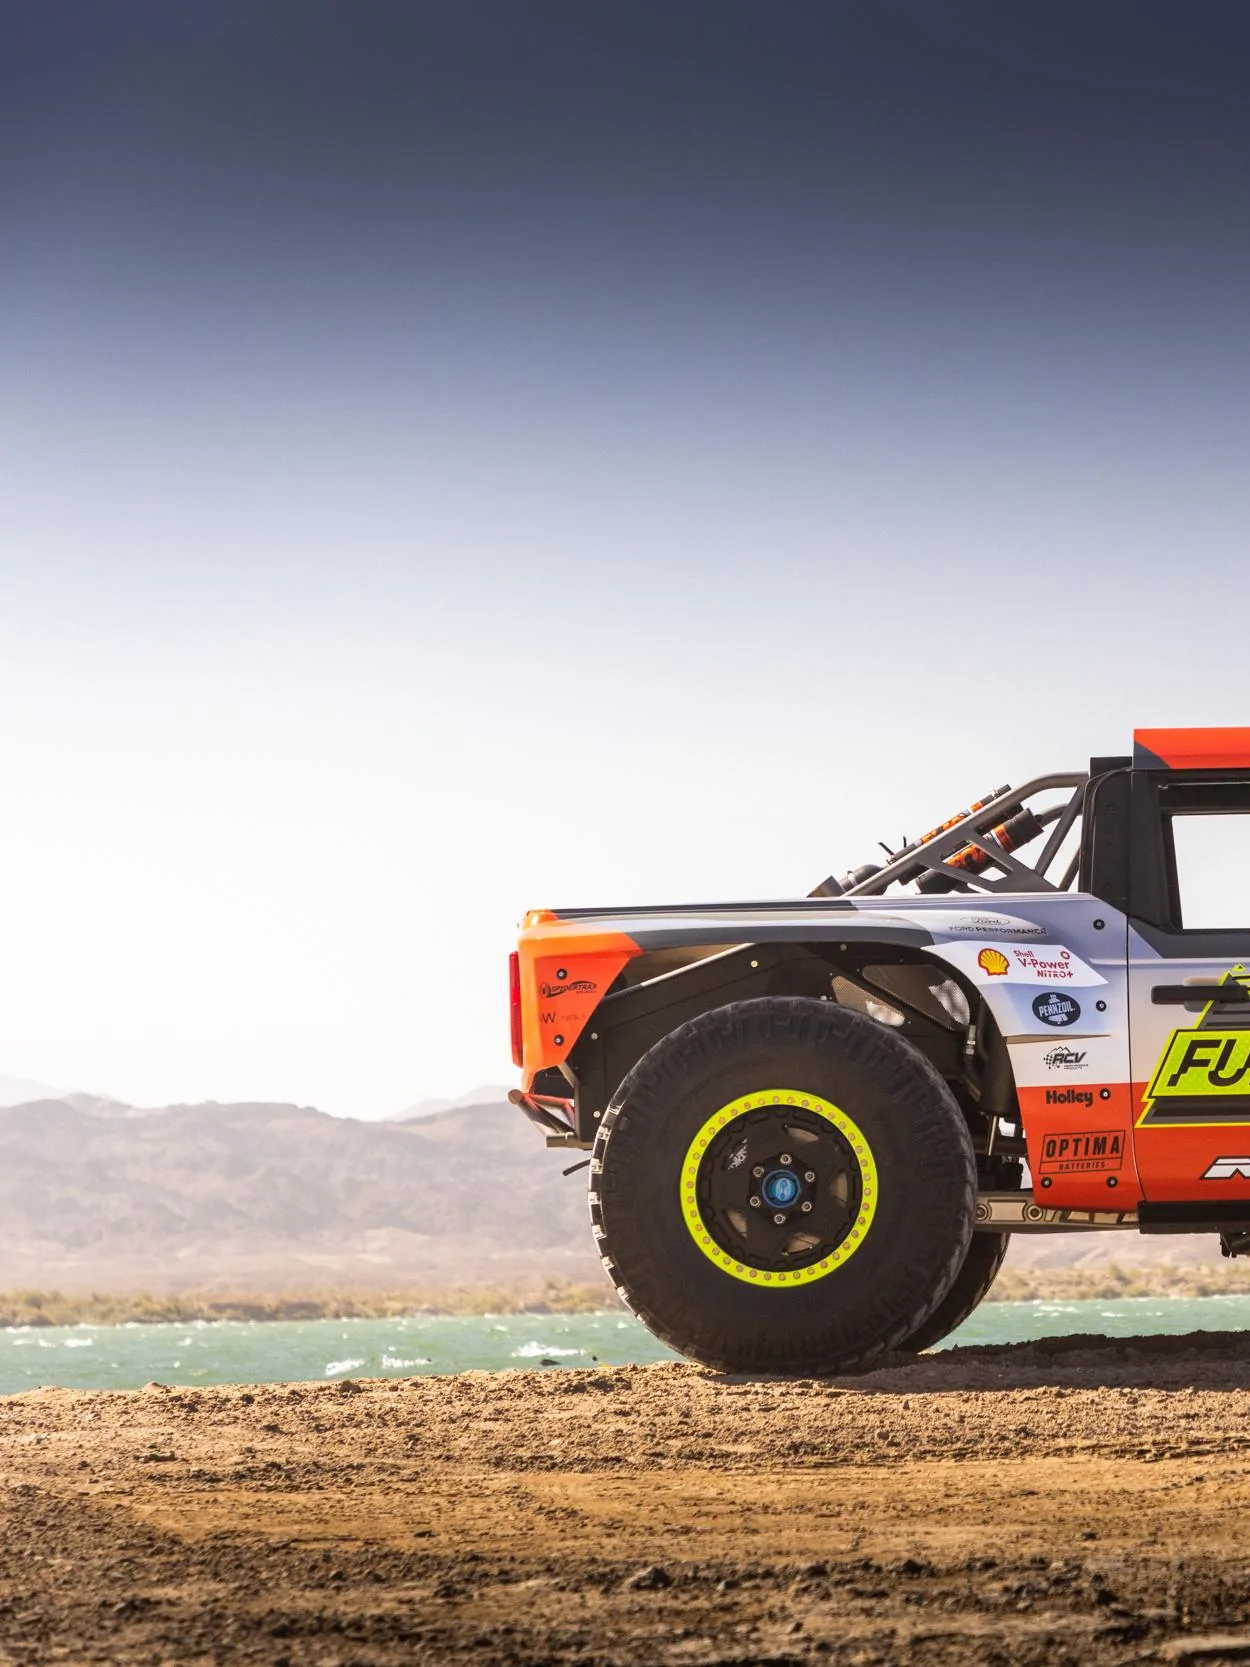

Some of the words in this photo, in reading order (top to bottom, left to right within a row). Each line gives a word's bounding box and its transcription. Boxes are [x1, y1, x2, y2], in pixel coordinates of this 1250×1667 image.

[976, 926, 1048, 934] PERFORMANCE
[1013, 950, 1034, 958] Shell
[1017, 958, 1070, 970] V-Power
[1038, 1001, 1074, 1017] PENNZOIL
[1051, 1052, 1087, 1064] RCV
[1045, 1089, 1093, 1108] Holley
[1046, 1135, 1120, 1158] OPTIMA
[1058, 1161, 1106, 1171] BATTERIES
